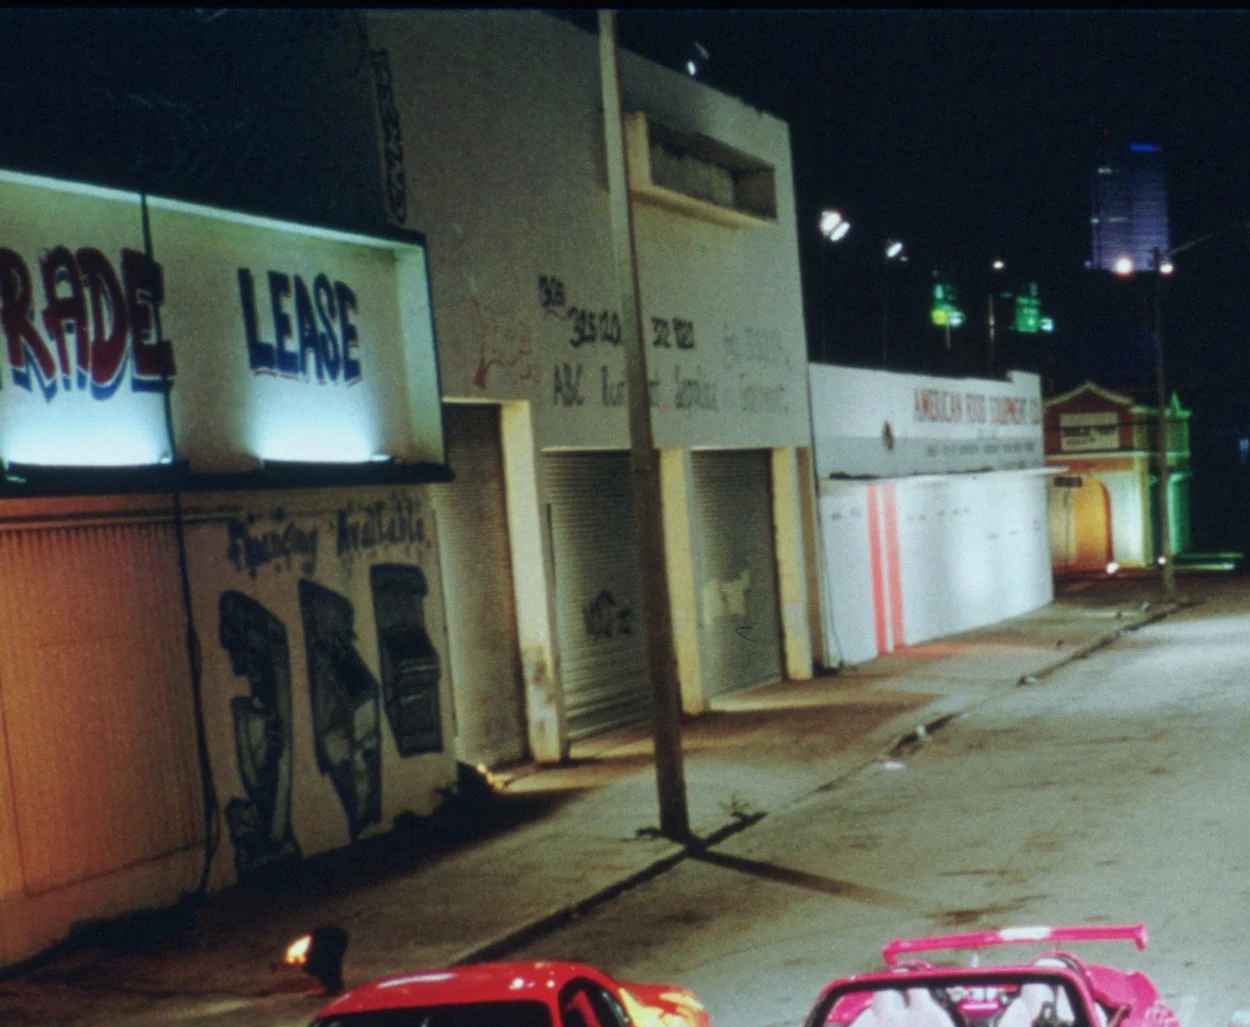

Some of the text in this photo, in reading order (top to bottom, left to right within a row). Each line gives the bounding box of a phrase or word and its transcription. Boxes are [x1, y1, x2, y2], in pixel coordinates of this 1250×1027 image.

[0, 246, 176, 402] RADE
[238, 267, 362, 386] LEASE
[913, 387, 963, 422] AMERICAN
